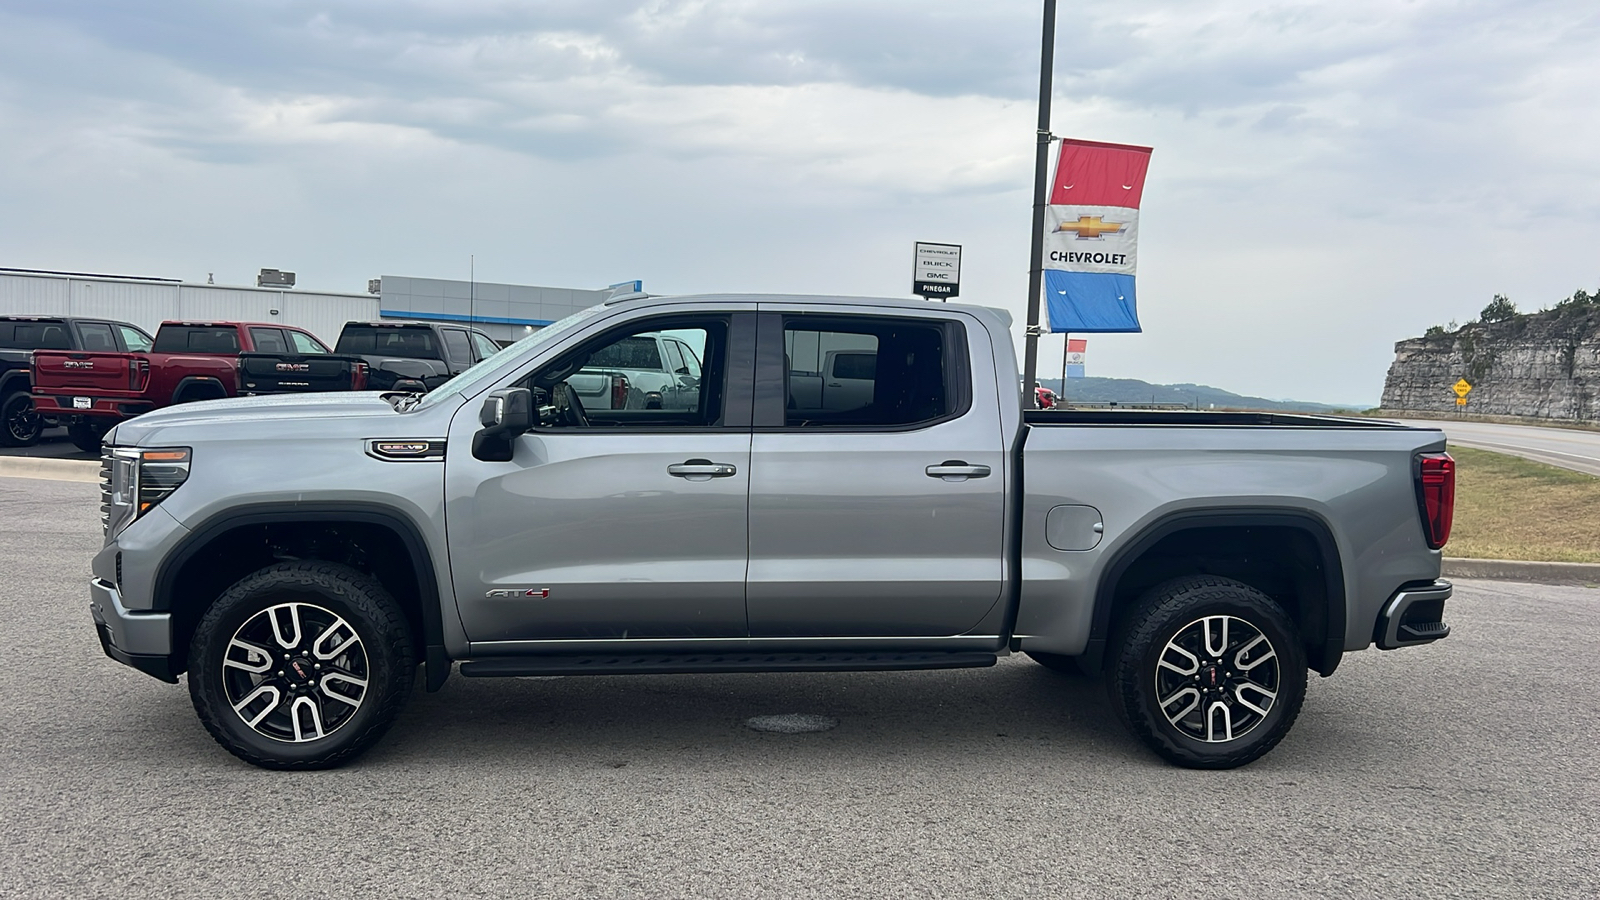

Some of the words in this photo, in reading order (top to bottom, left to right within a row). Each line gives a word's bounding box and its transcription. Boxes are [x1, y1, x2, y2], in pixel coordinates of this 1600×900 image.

[1050, 251, 1126, 265] CHEVROLET
[922, 284, 950, 292] PINEGAR
[63, 361, 93, 369] GMC
[275, 363, 309, 371] GMC
[485, 588, 550, 600] AT4
